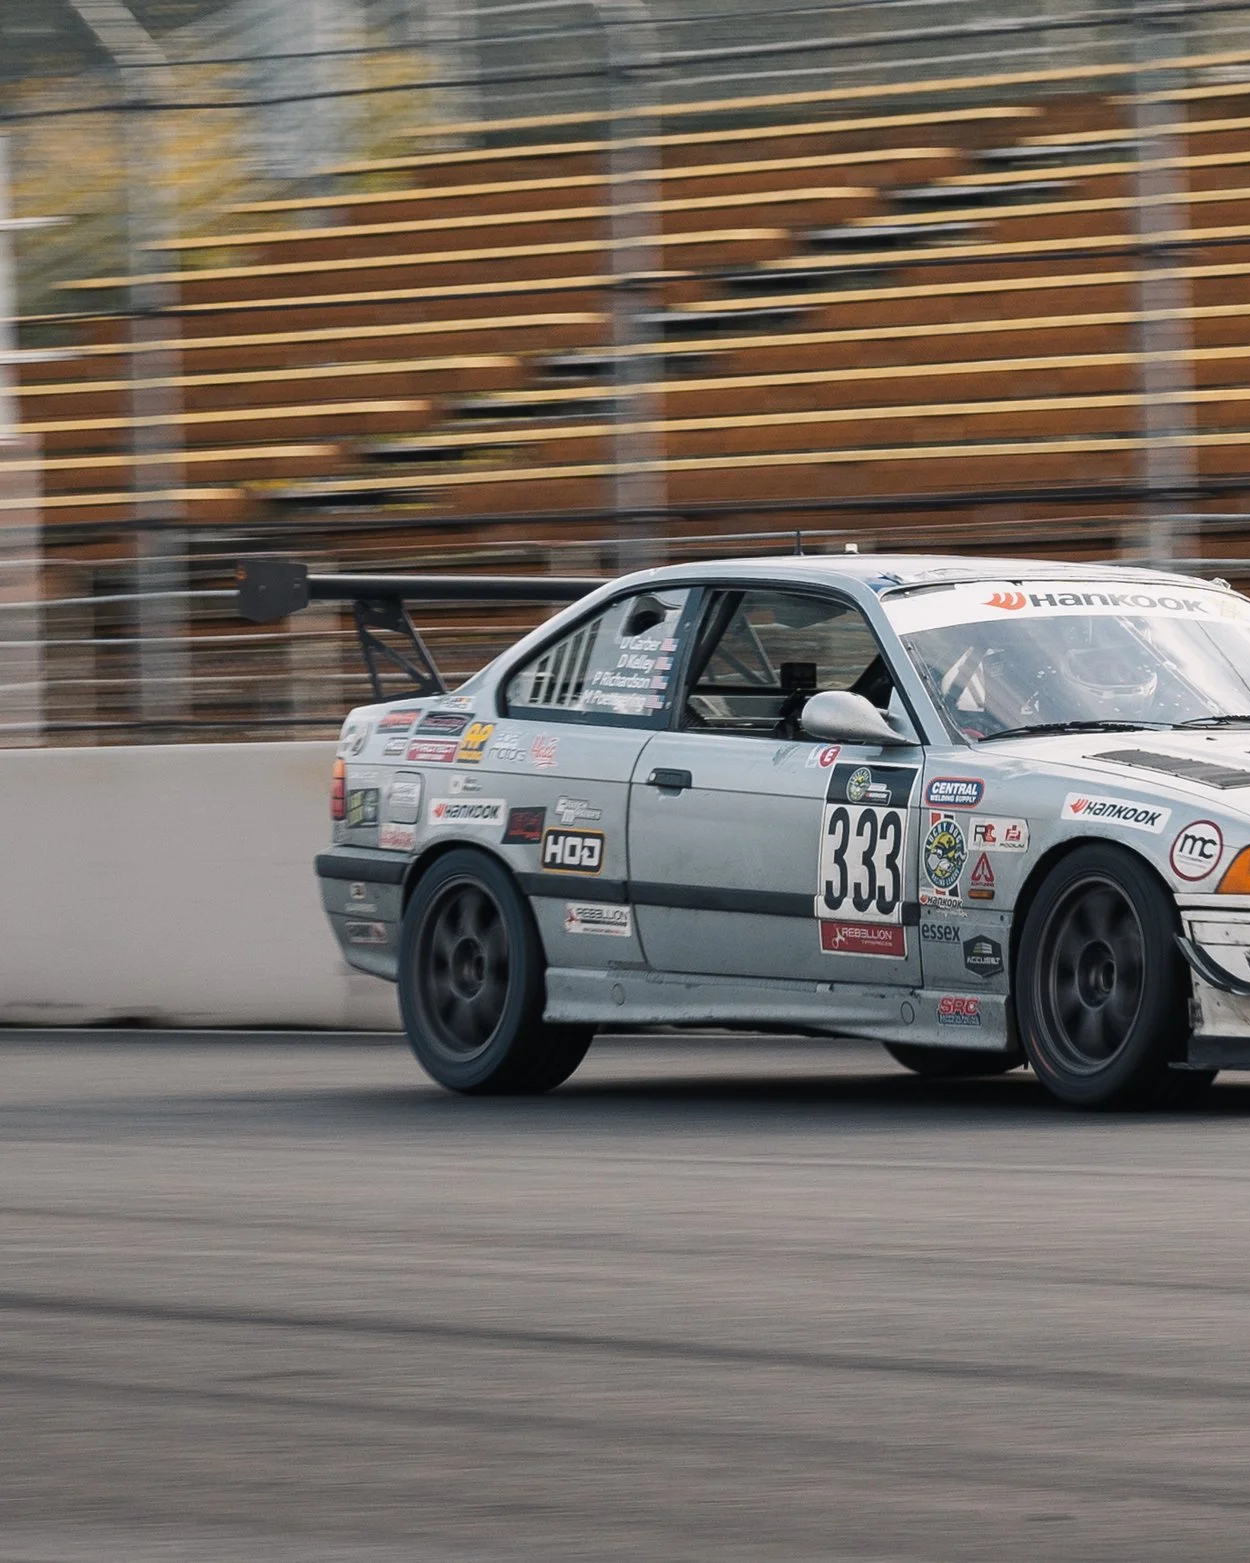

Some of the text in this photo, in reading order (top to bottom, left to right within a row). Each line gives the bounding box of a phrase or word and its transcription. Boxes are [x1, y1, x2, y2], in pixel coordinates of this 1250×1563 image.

[931, 782, 978, 795] CENTRAL
[929, 794, 977, 803] WELDING SUPPLY
[926, 822, 961, 850] LUCKY DOG
[824, 807, 902, 915] 333
[576, 907, 627, 920] REBELLION
[842, 927, 893, 940] REBELLION
[921, 923, 961, 942] essex
